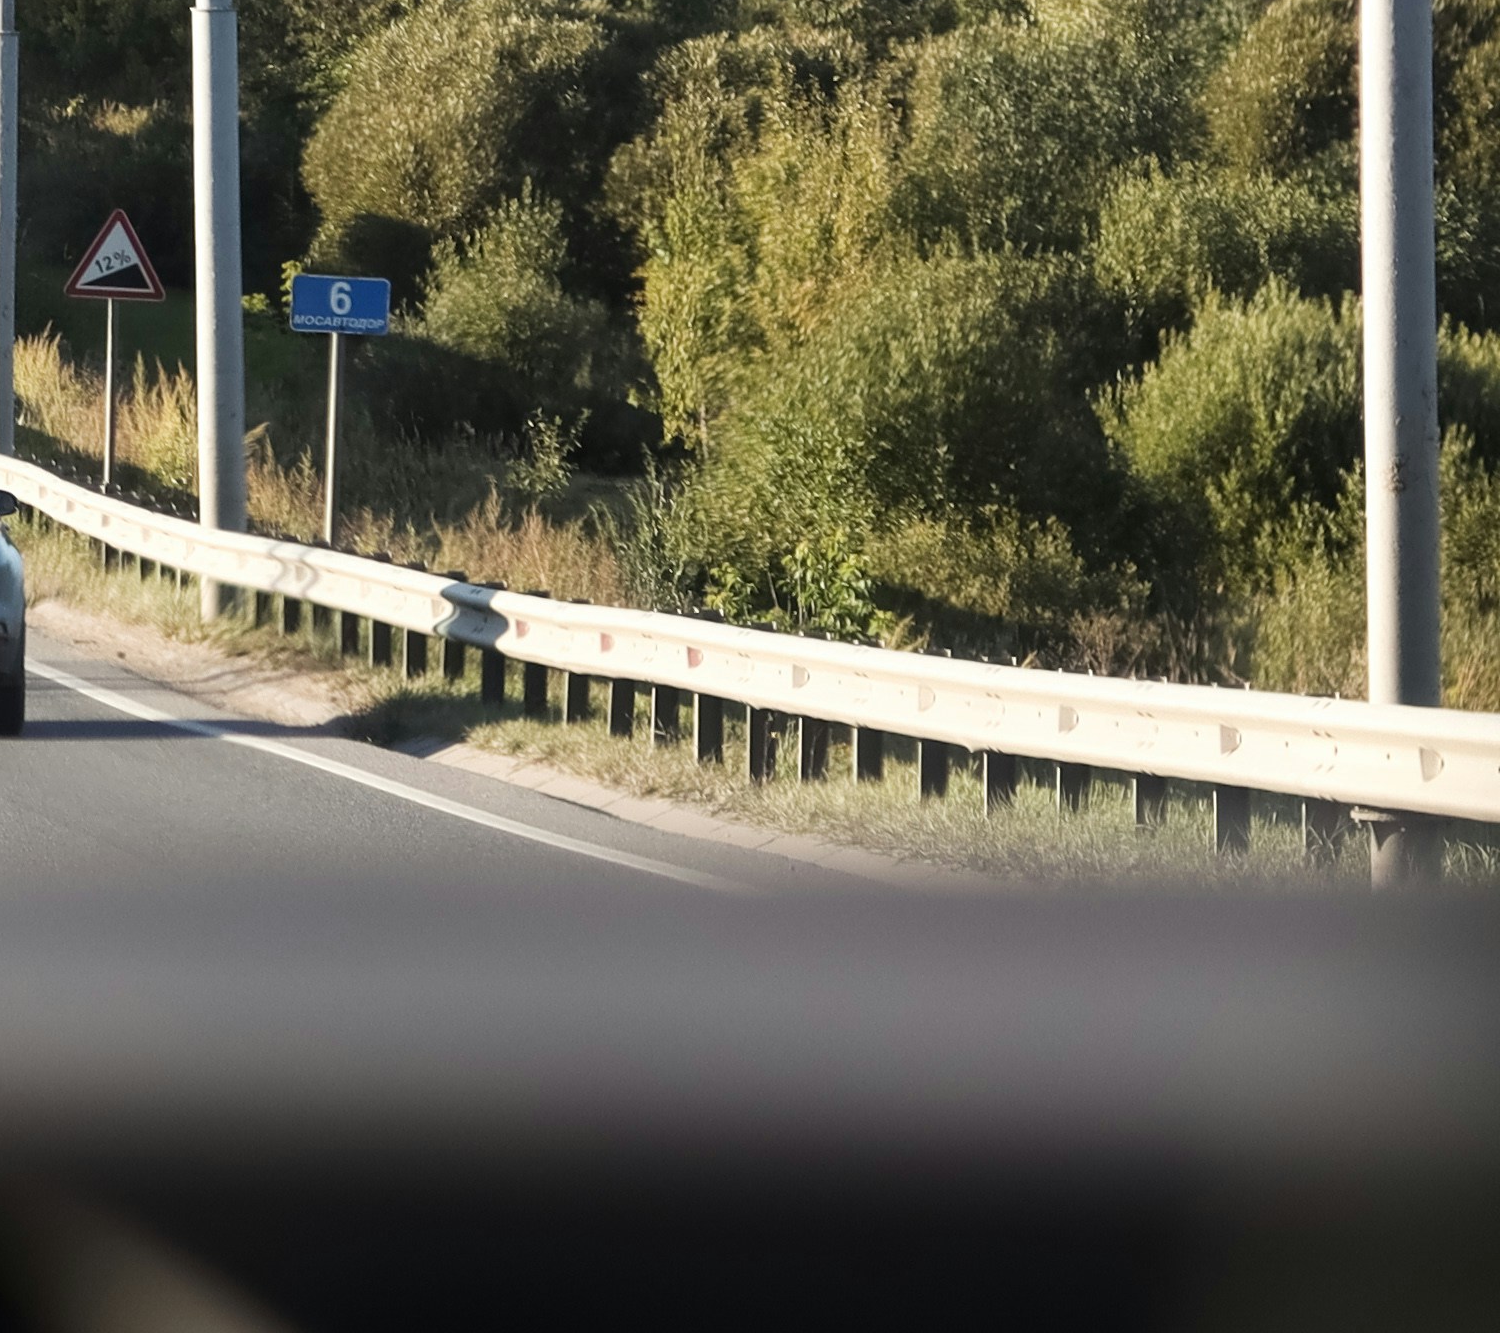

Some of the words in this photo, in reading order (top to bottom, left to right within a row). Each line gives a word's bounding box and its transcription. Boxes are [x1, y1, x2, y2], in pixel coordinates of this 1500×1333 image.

[95, 250, 131, 273] 12%
[331, 281, 352, 315] 6
[293, 314, 385, 330] МОСАВТОДОР
